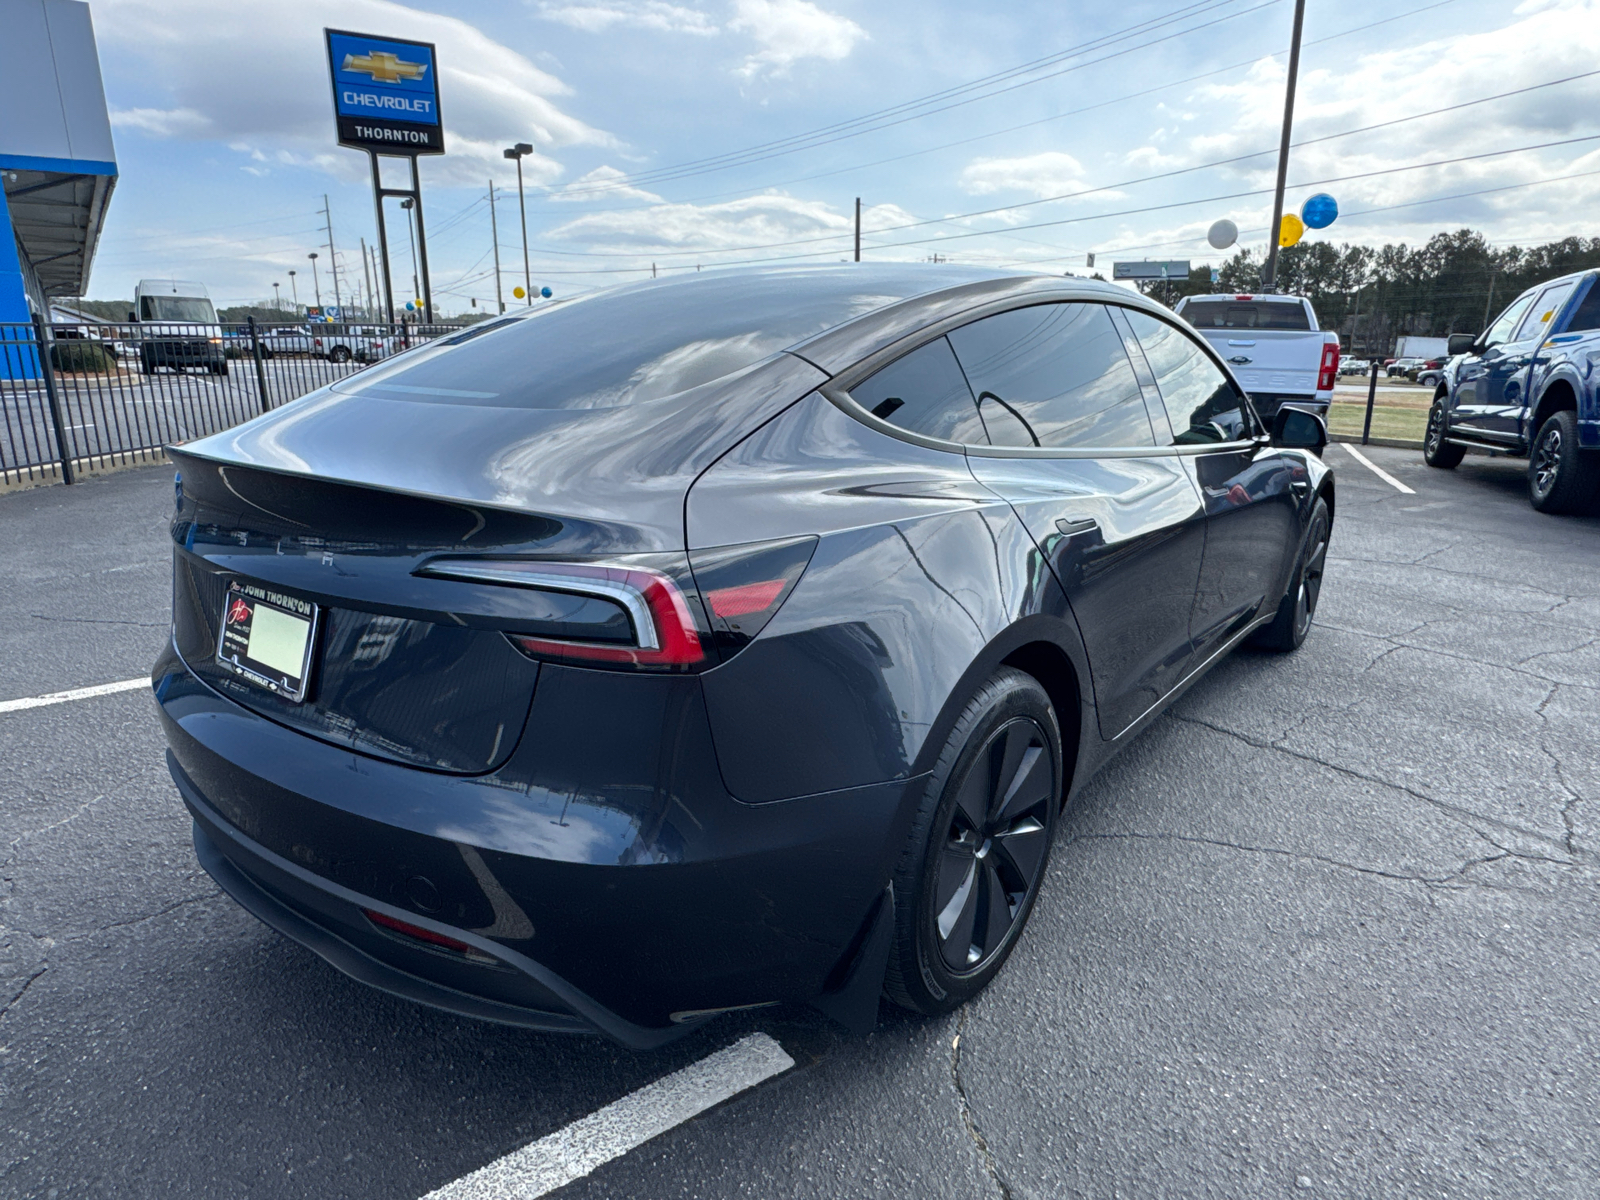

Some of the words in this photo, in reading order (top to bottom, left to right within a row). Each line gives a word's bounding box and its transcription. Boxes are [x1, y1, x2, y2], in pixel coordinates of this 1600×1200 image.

[343, 91, 431, 113] CHEVROLET
[355, 125, 429, 143] THORNTON
[244, 584, 266, 599] JOHN
[266, 590, 312, 615] THORNTON
